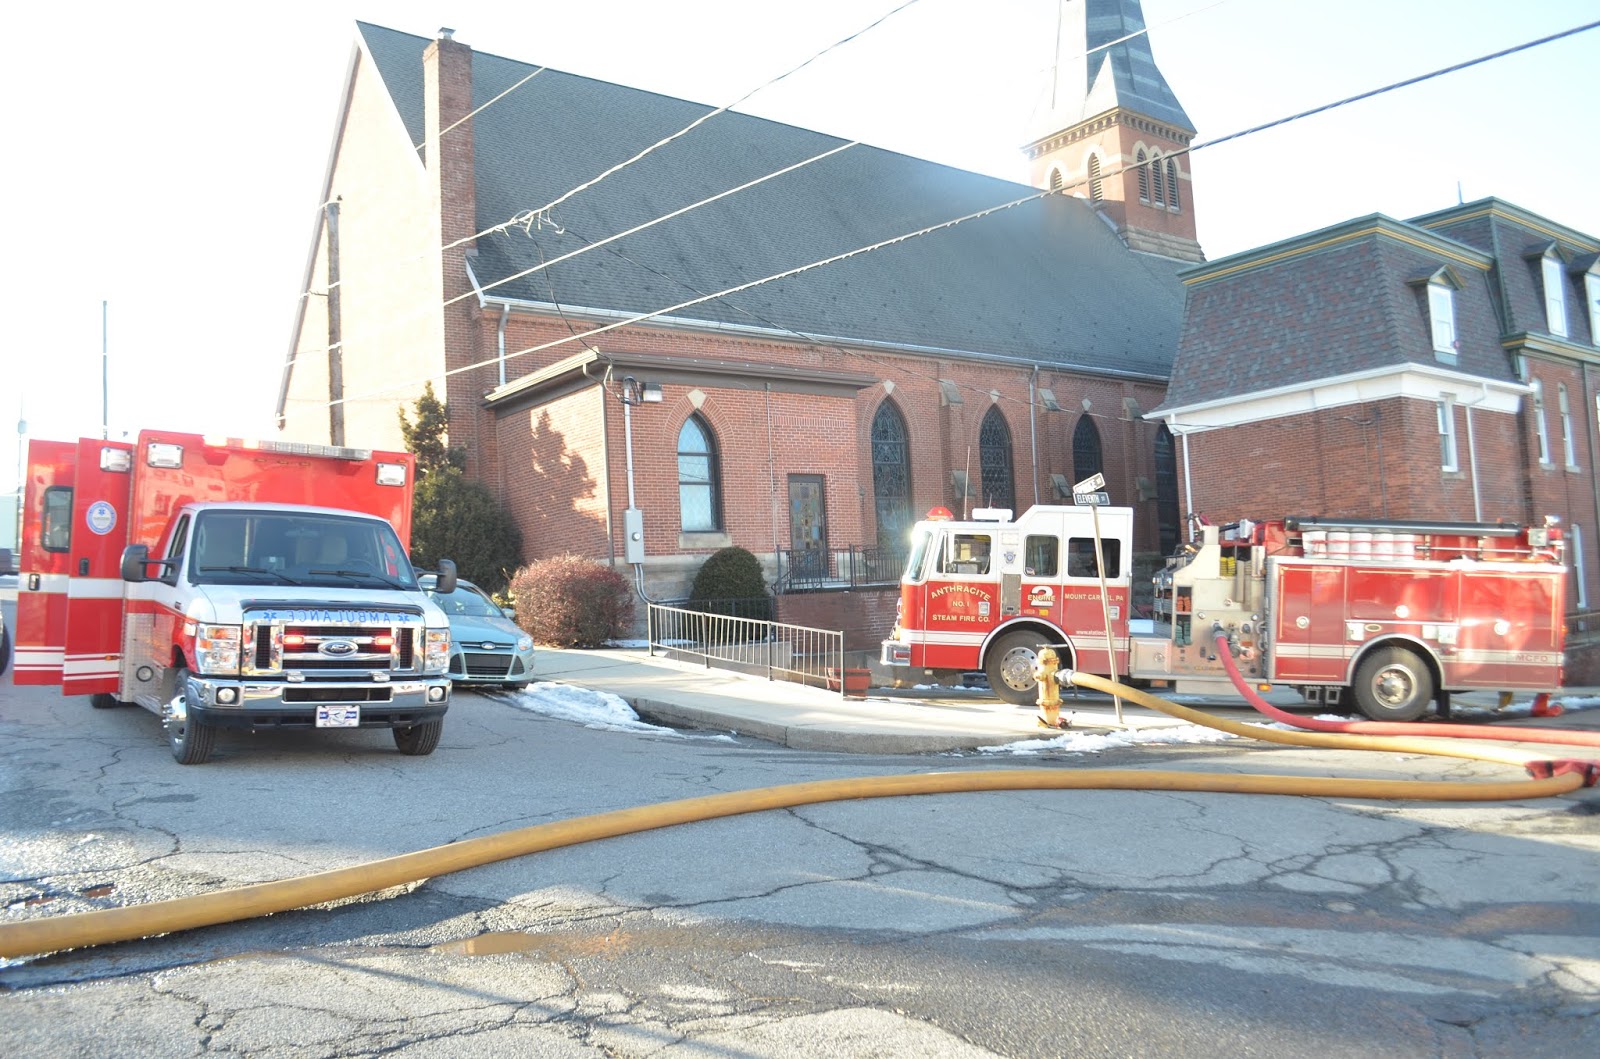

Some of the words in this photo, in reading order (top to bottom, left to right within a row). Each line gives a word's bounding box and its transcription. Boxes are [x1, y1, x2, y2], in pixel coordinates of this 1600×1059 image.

[931, 585, 991, 601] ANTHRACITE
[1027, 594, 1056, 602] ENGINE
[1030, 585, 1054, 608] 2
